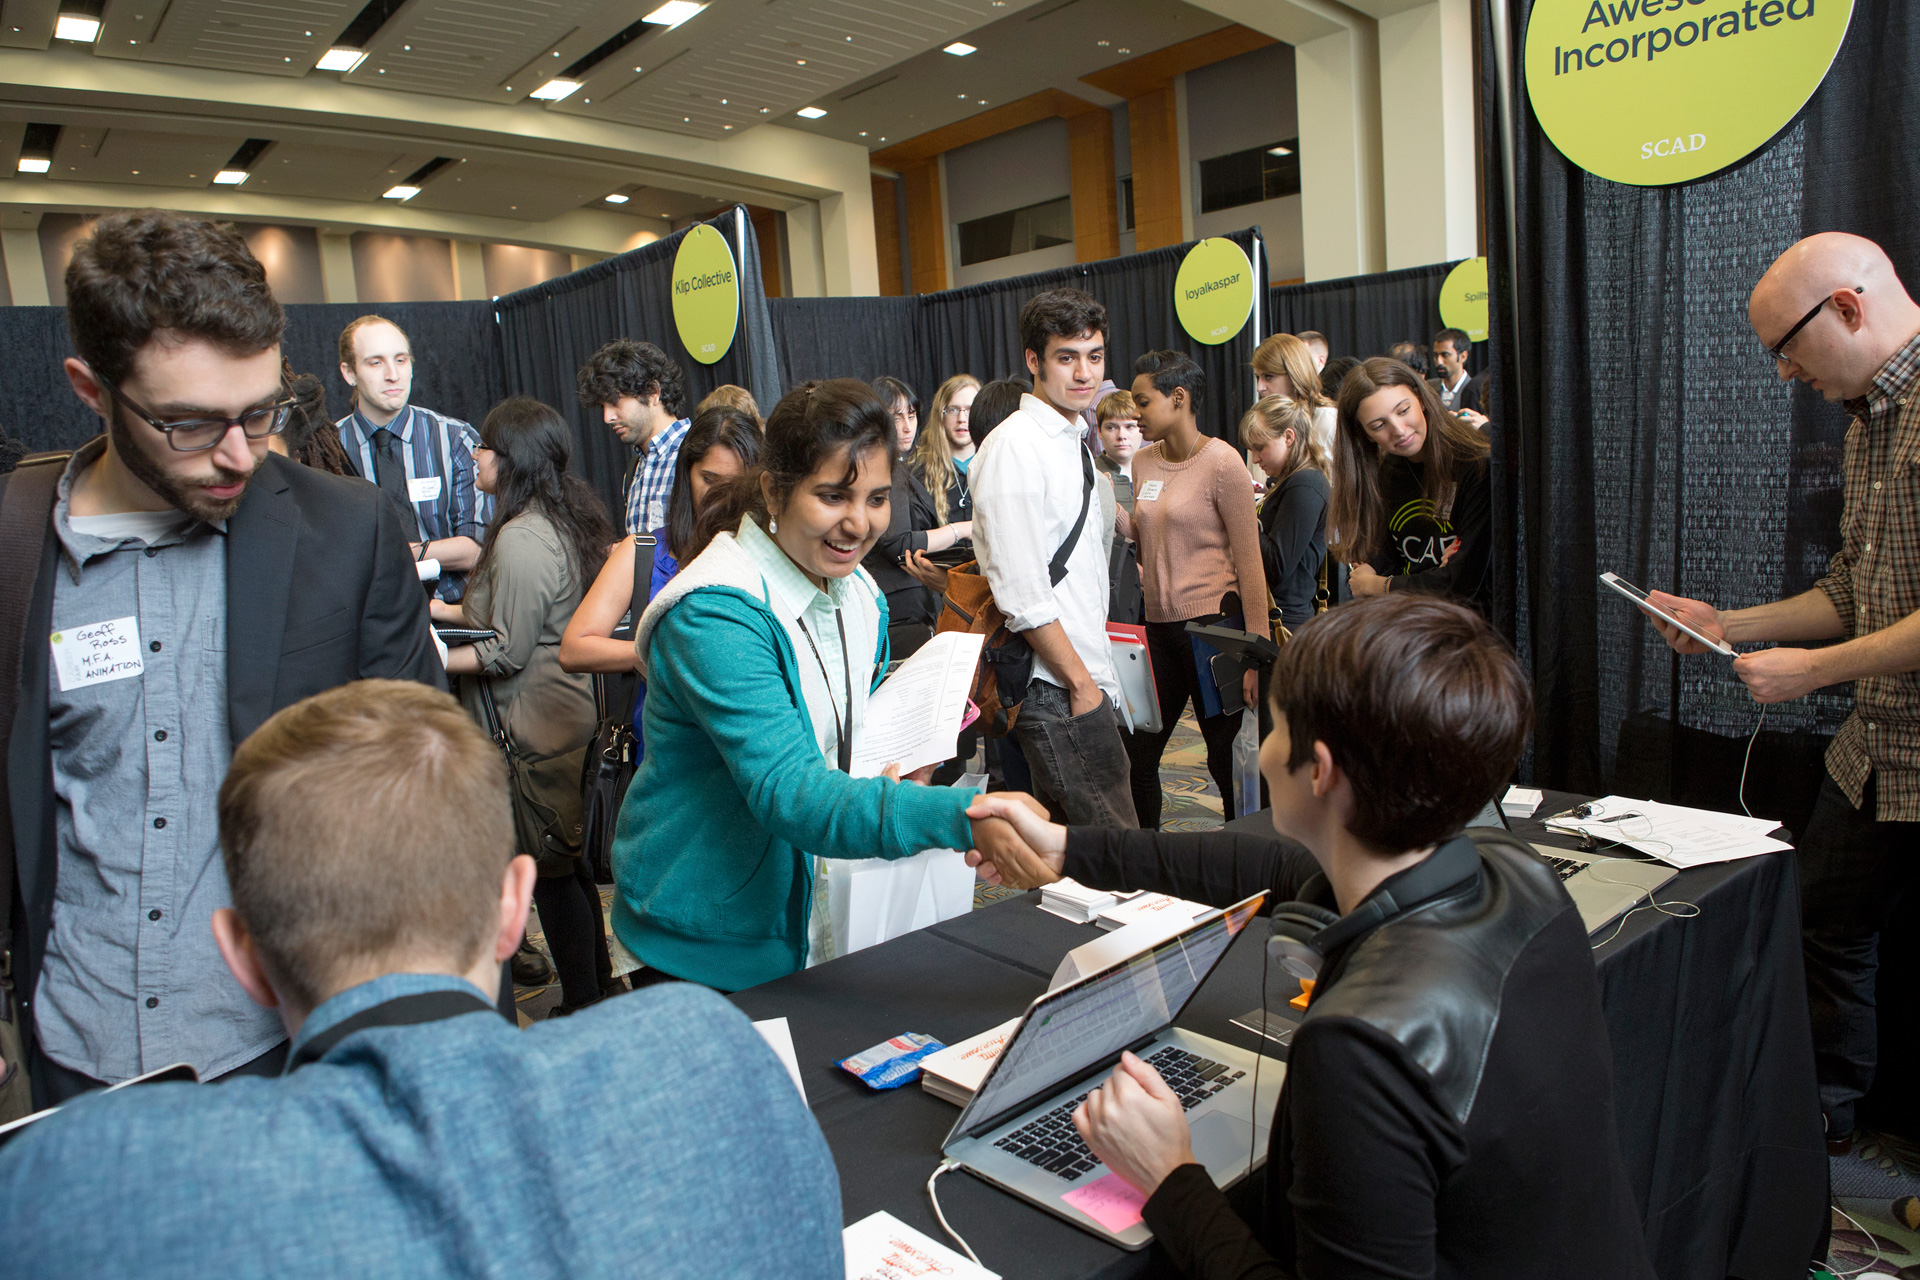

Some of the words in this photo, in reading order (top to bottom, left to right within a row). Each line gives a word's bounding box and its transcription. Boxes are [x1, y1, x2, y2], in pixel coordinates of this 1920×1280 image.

[1581, 0, 1701, 34] Awes
[1555, 0, 1815, 76] Incorporated
[1640, 133, 1707, 160] SCAD
[675, 279, 691, 296] Klip
[691, 270, 732, 291] Collective
[1185, 273, 1240, 301] loyalkaspar
[1210, 325, 1228, 337] SCAD
[701, 343, 716, 353] SCAD
[76, 622, 116, 641] Geoff
[89, 635, 128, 650] Ross
[86, 659, 142, 679] ANIMATION
